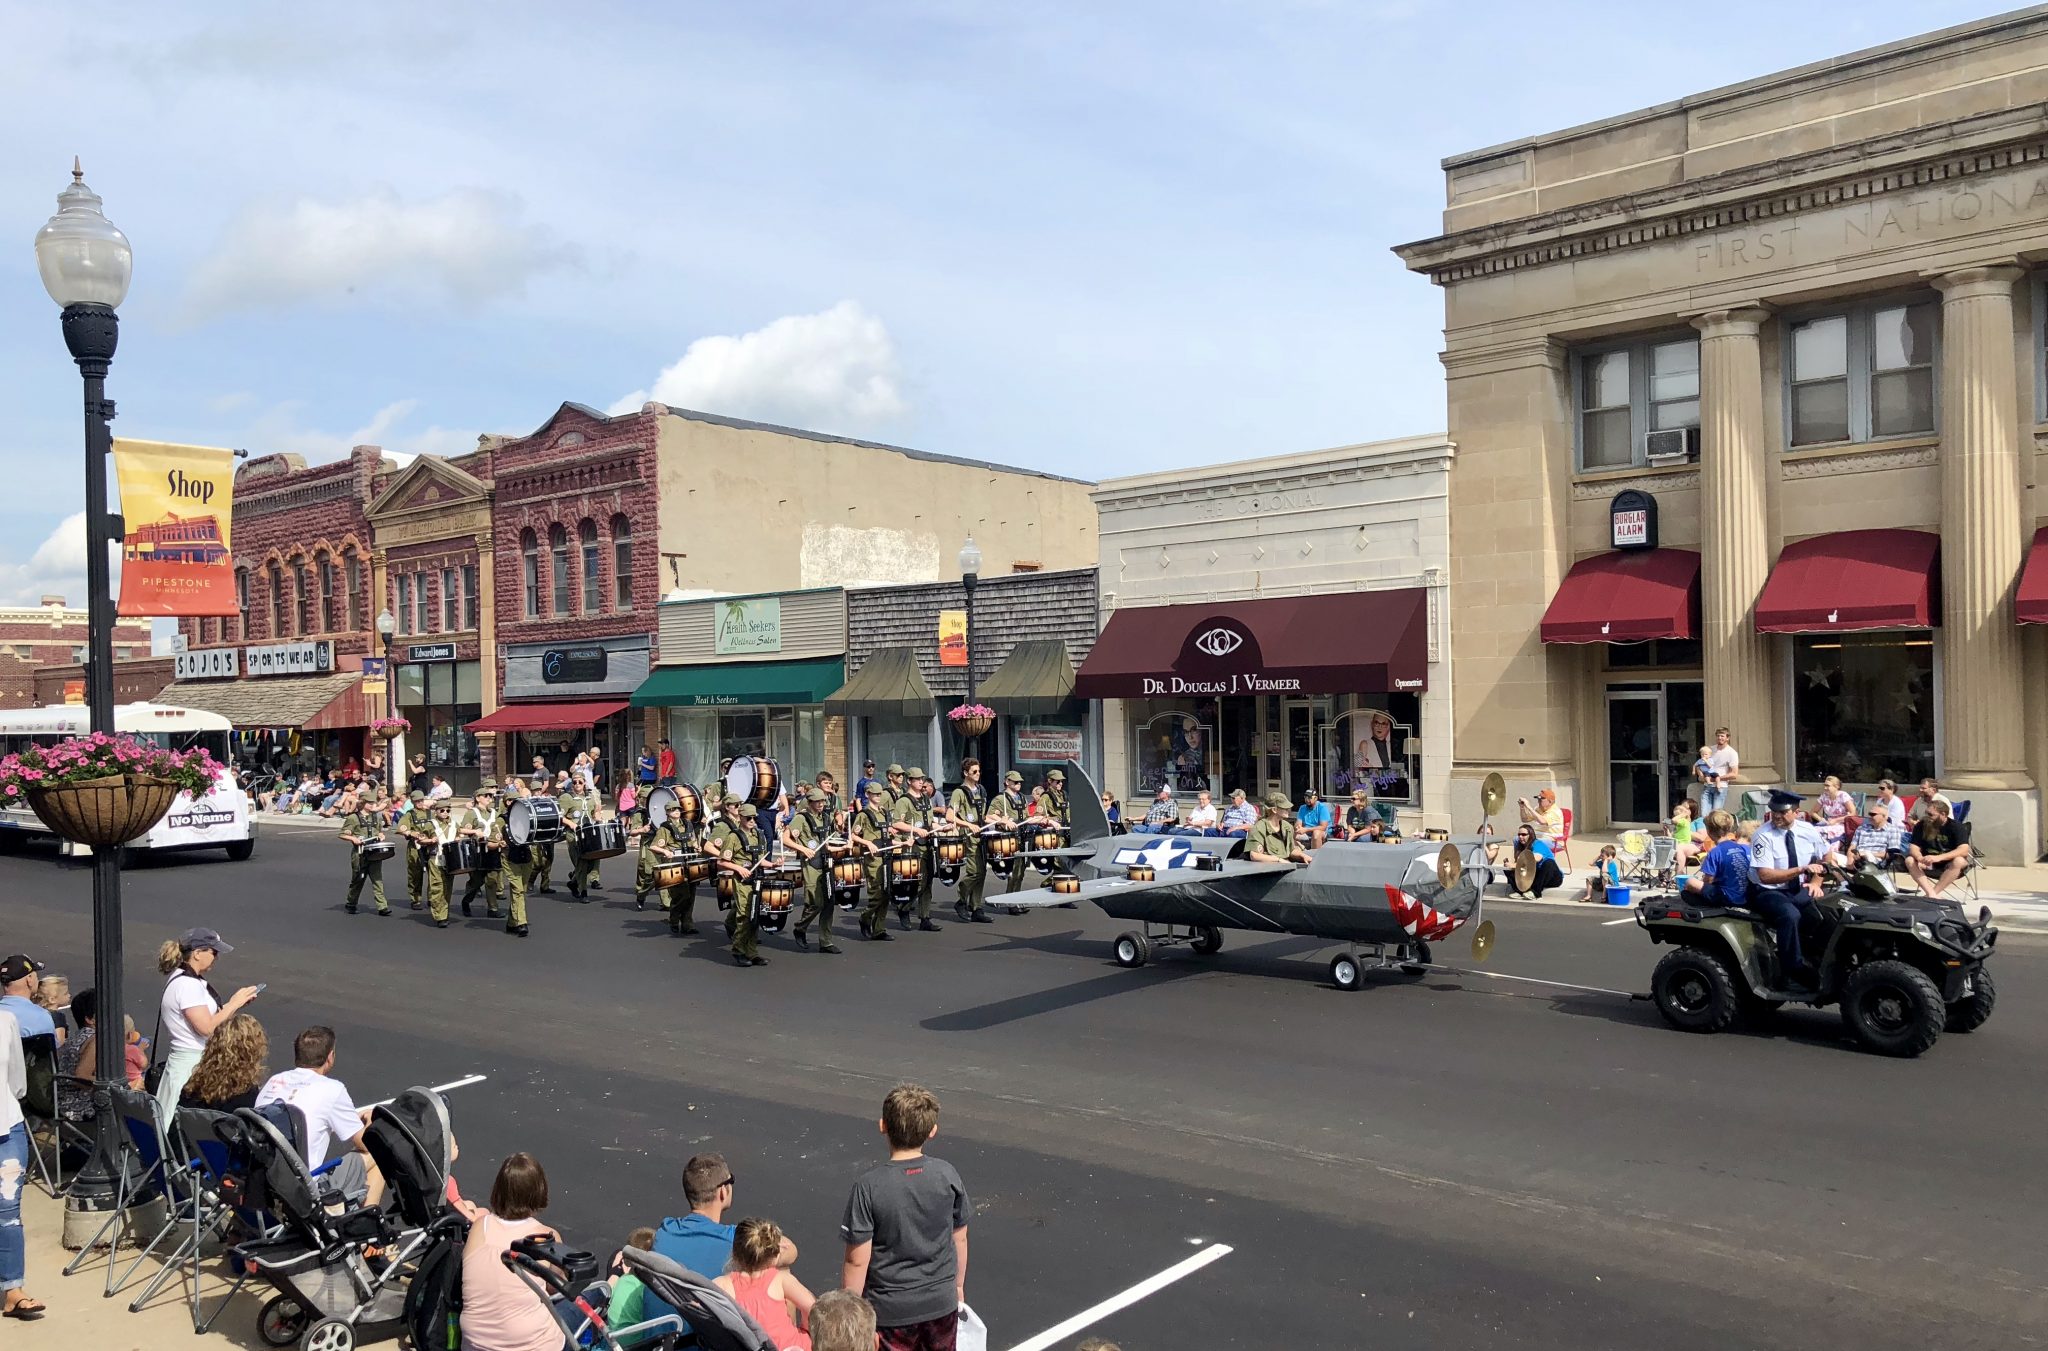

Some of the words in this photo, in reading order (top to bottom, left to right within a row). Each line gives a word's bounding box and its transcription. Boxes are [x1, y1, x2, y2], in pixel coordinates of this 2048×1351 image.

[1695, 226, 1800, 273] FIRST
[167, 468, 214, 504] Shop
[1237, 490, 1323, 514] COLONIAL
[1614, 511, 1646, 525] BURGLAR
[1617, 523, 1643, 536] ALARM
[142, 577, 211, 588] PIPESTONE
[726, 620, 748, 635] Health
[749, 619, 776, 633] Seekers
[177, 652, 233, 675] SOJO'S
[1143, 678, 1168, 694] DR.
[1171, 677, 1227, 694] DOUGLAS
[1230, 674, 1240, 695] J.
[1243, 674, 1301, 691] VERMEER
[716, 694, 738, 704] Seekers
[1020, 740, 1052, 749] COMING
[170, 815, 191, 827] No
[191, 813, 232, 825] Name
